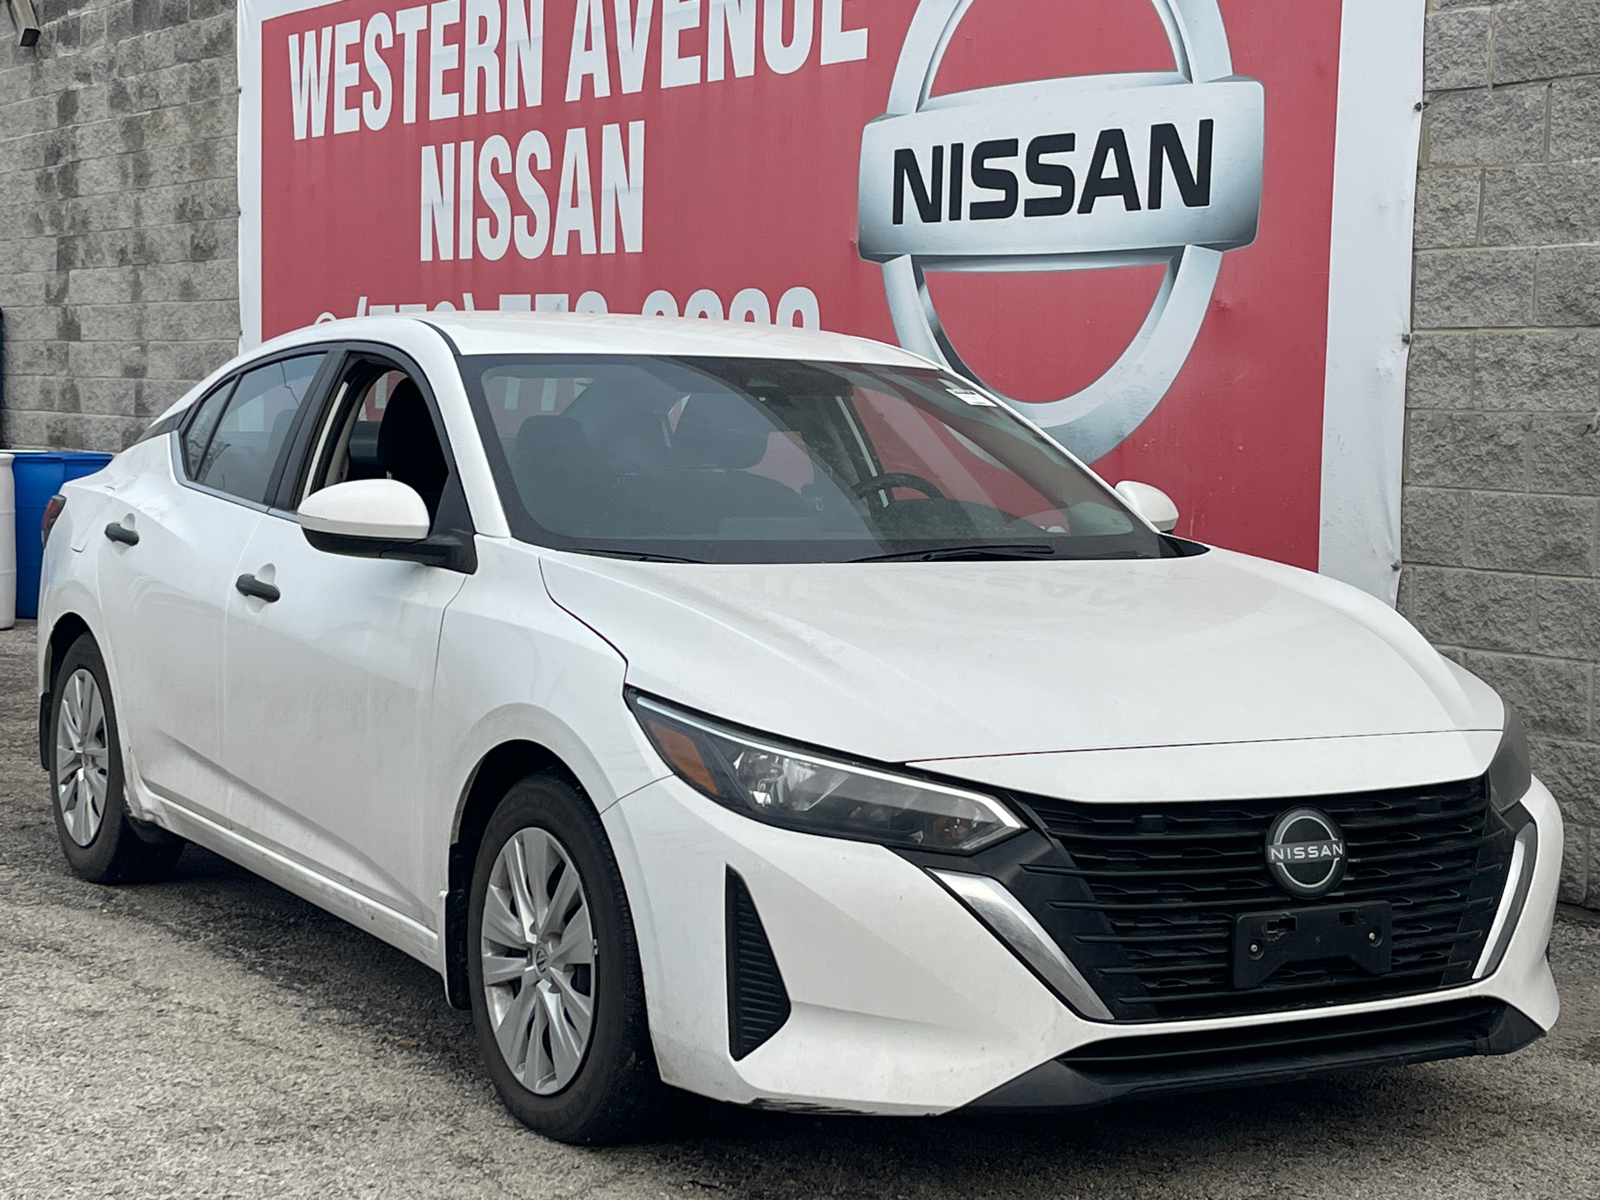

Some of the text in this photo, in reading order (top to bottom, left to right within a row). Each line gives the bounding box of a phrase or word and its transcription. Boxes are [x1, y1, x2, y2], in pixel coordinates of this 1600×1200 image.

[288, 0, 544, 140] WESTERN
[420, 120, 645, 261] NISSAN
[892, 118, 1214, 226] NISSAN
[1270, 843, 1343, 860] NISSAN
